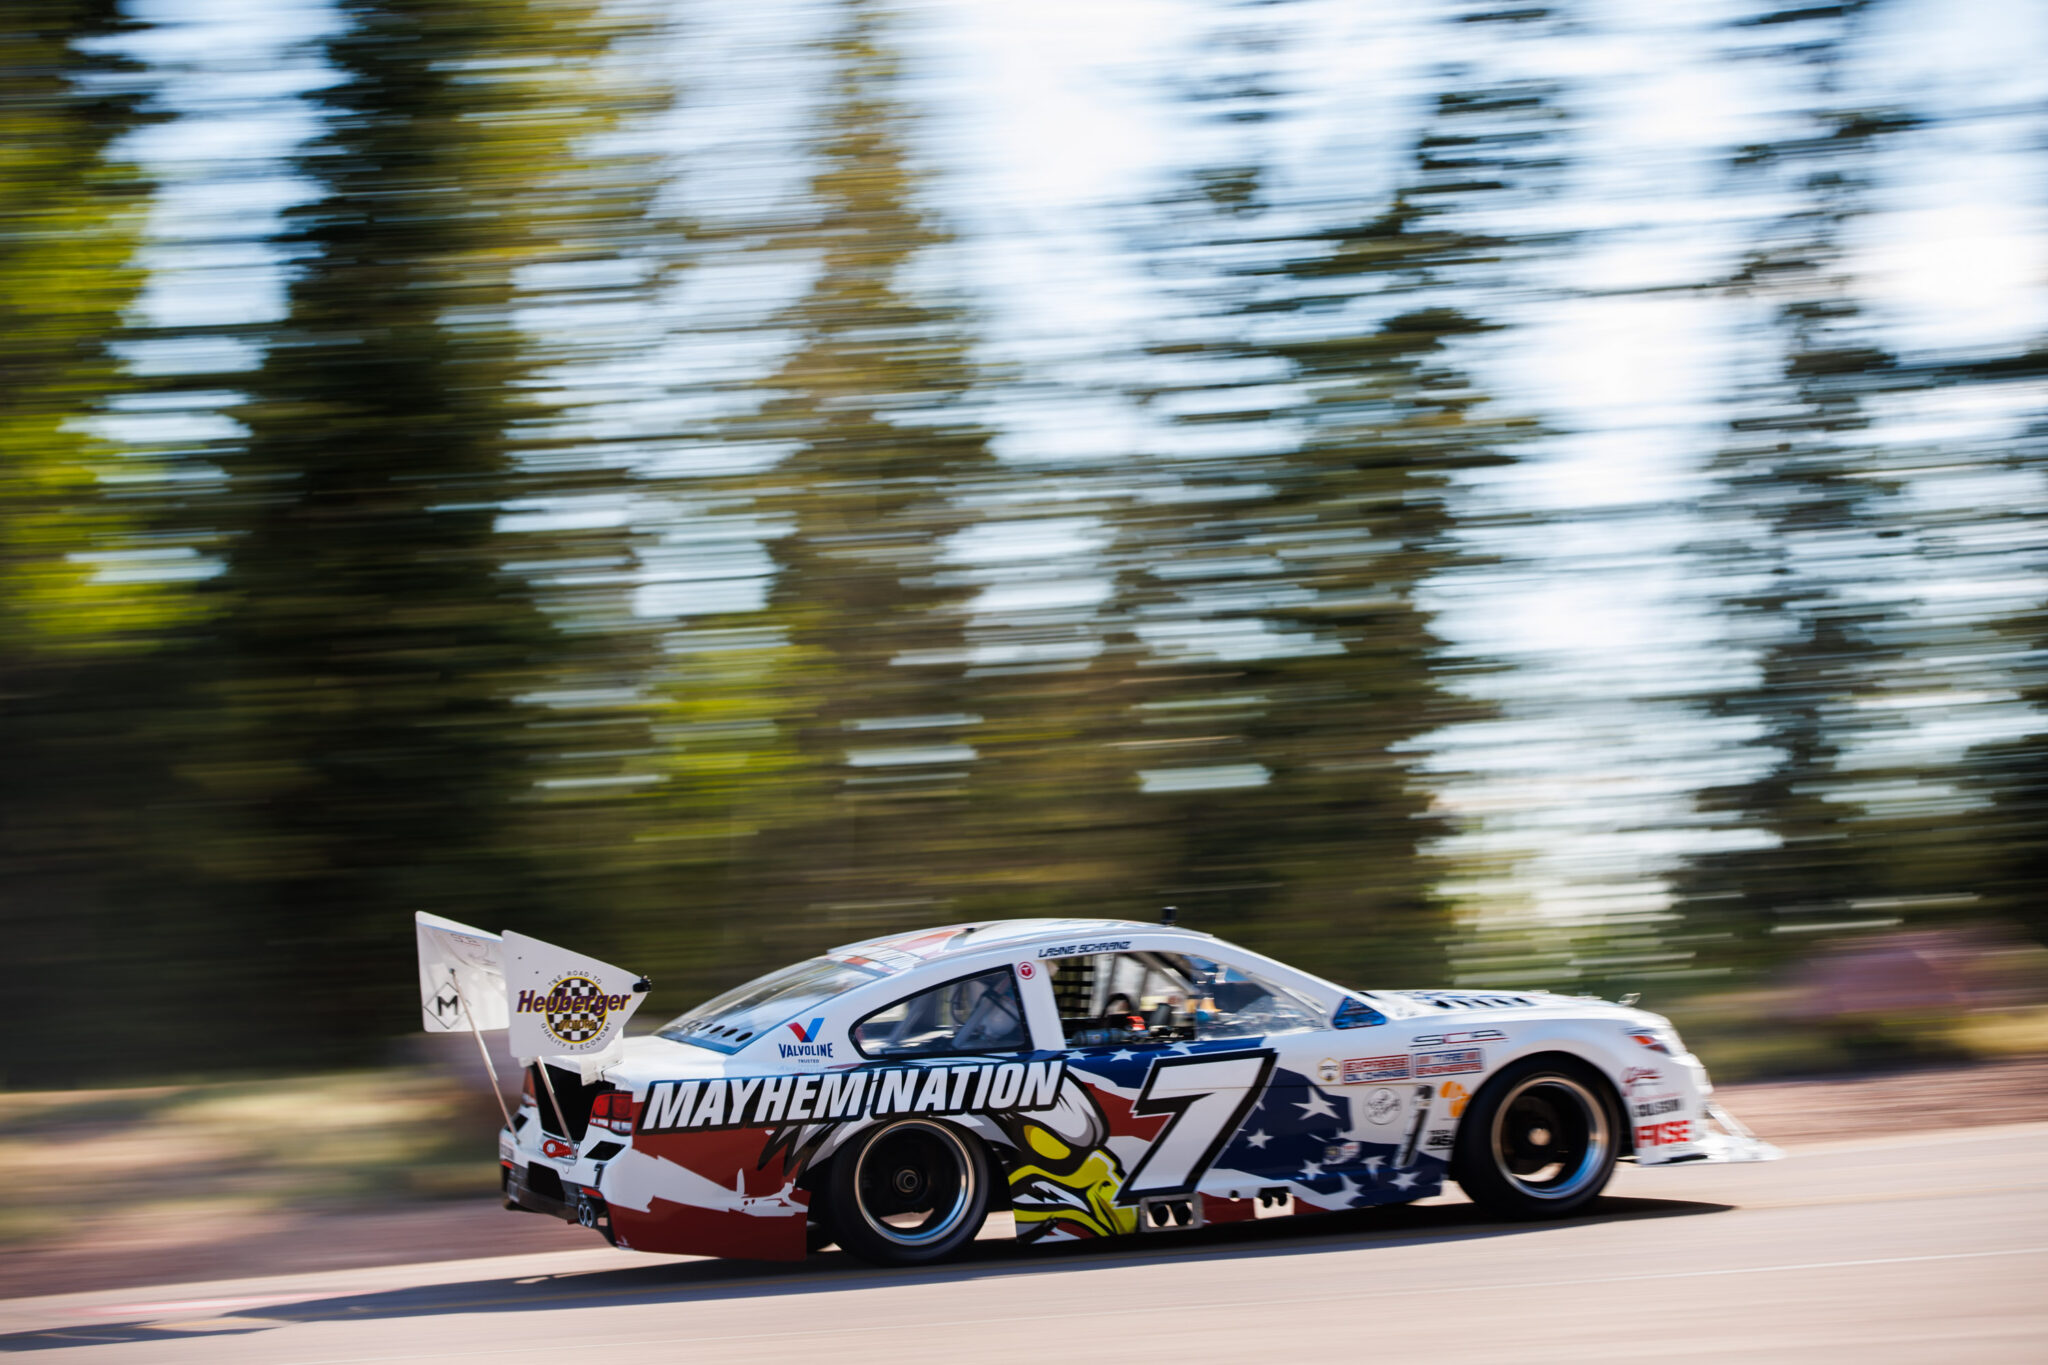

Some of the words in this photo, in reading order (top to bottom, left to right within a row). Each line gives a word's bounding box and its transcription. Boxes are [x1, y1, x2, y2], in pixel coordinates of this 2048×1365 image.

[1038, 945, 1077, 958] LAYNE
[593, 975, 602, 985] TO
[516, 988, 632, 1017] Heuberger
[540, 1022, 566, 1048] QUALITY
[580, 1021, 612, 1050] ECONOMY
[778, 1042, 834, 1059] VALVOLINE
[1118, 1050, 1269, 1204] 7
